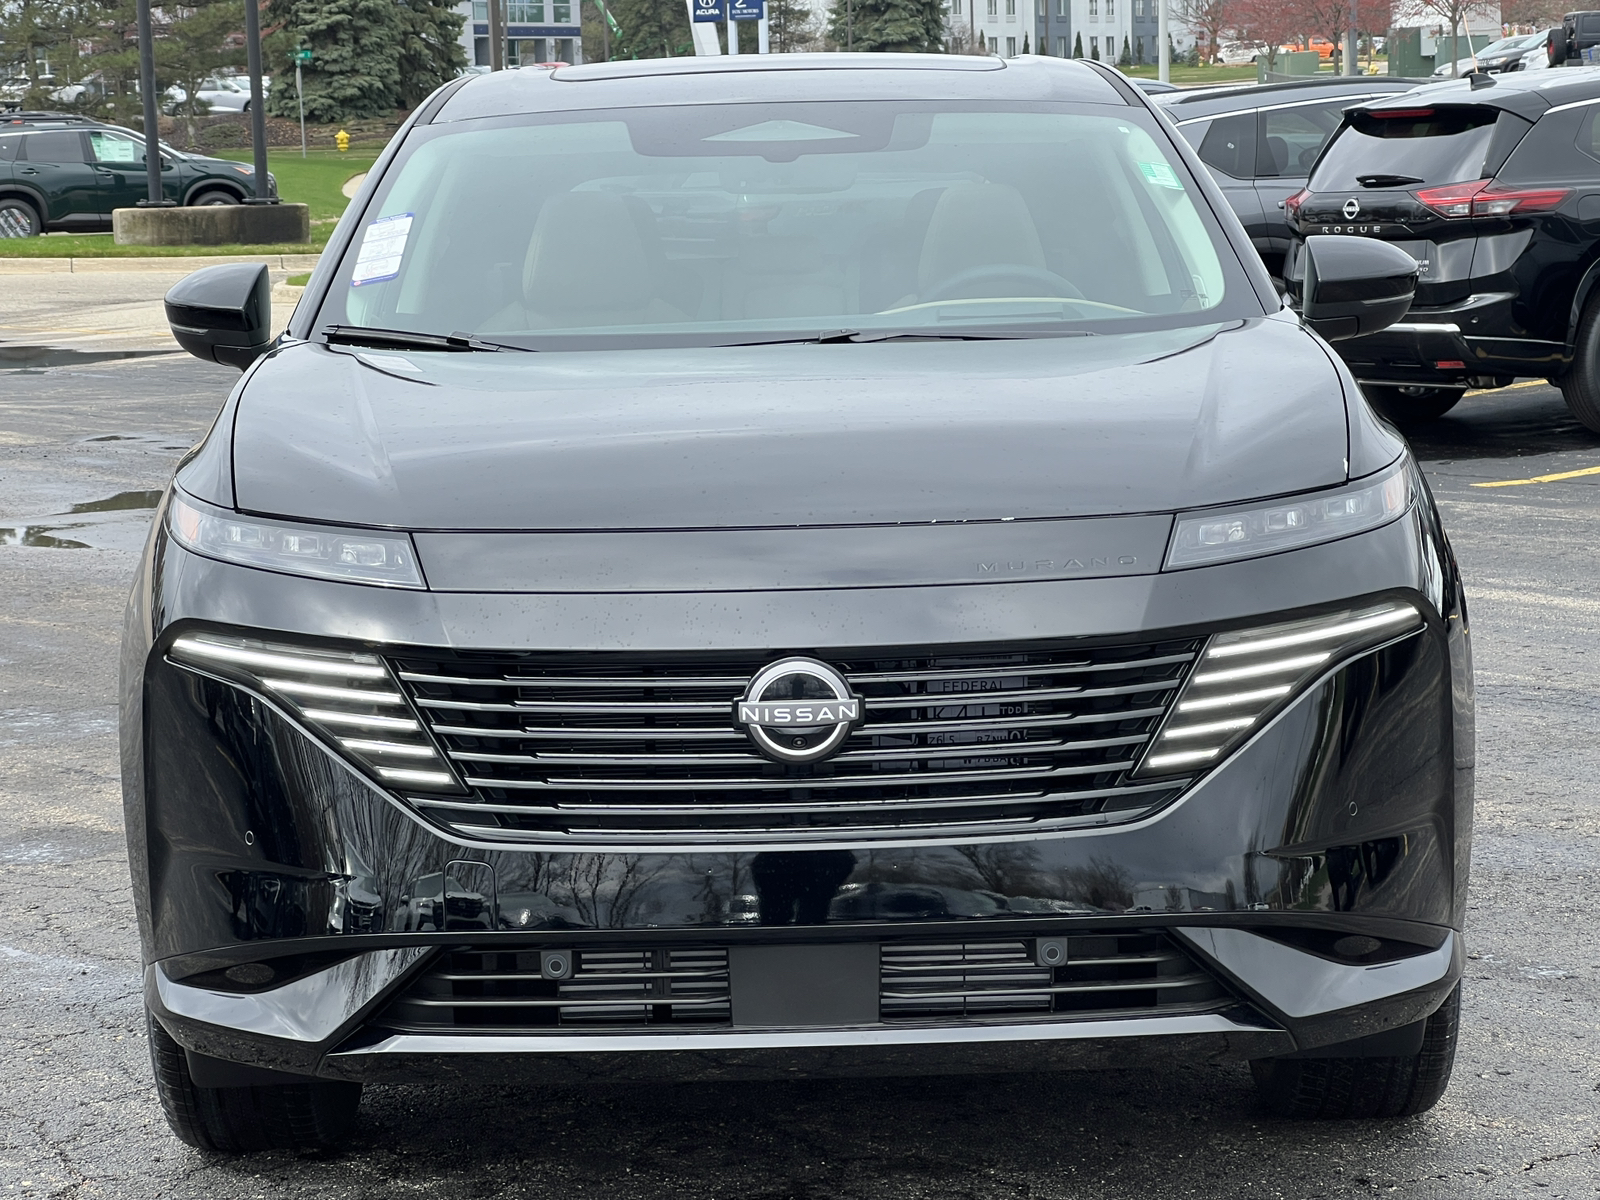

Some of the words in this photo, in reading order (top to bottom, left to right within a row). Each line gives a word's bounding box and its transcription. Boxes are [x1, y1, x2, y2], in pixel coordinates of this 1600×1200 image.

[1322, 226, 1381, 234] ROGUE
[976, 555, 1137, 573] MURANO
[741, 704, 856, 722] NISSAN
[1000, 706, 1022, 715] TDD
